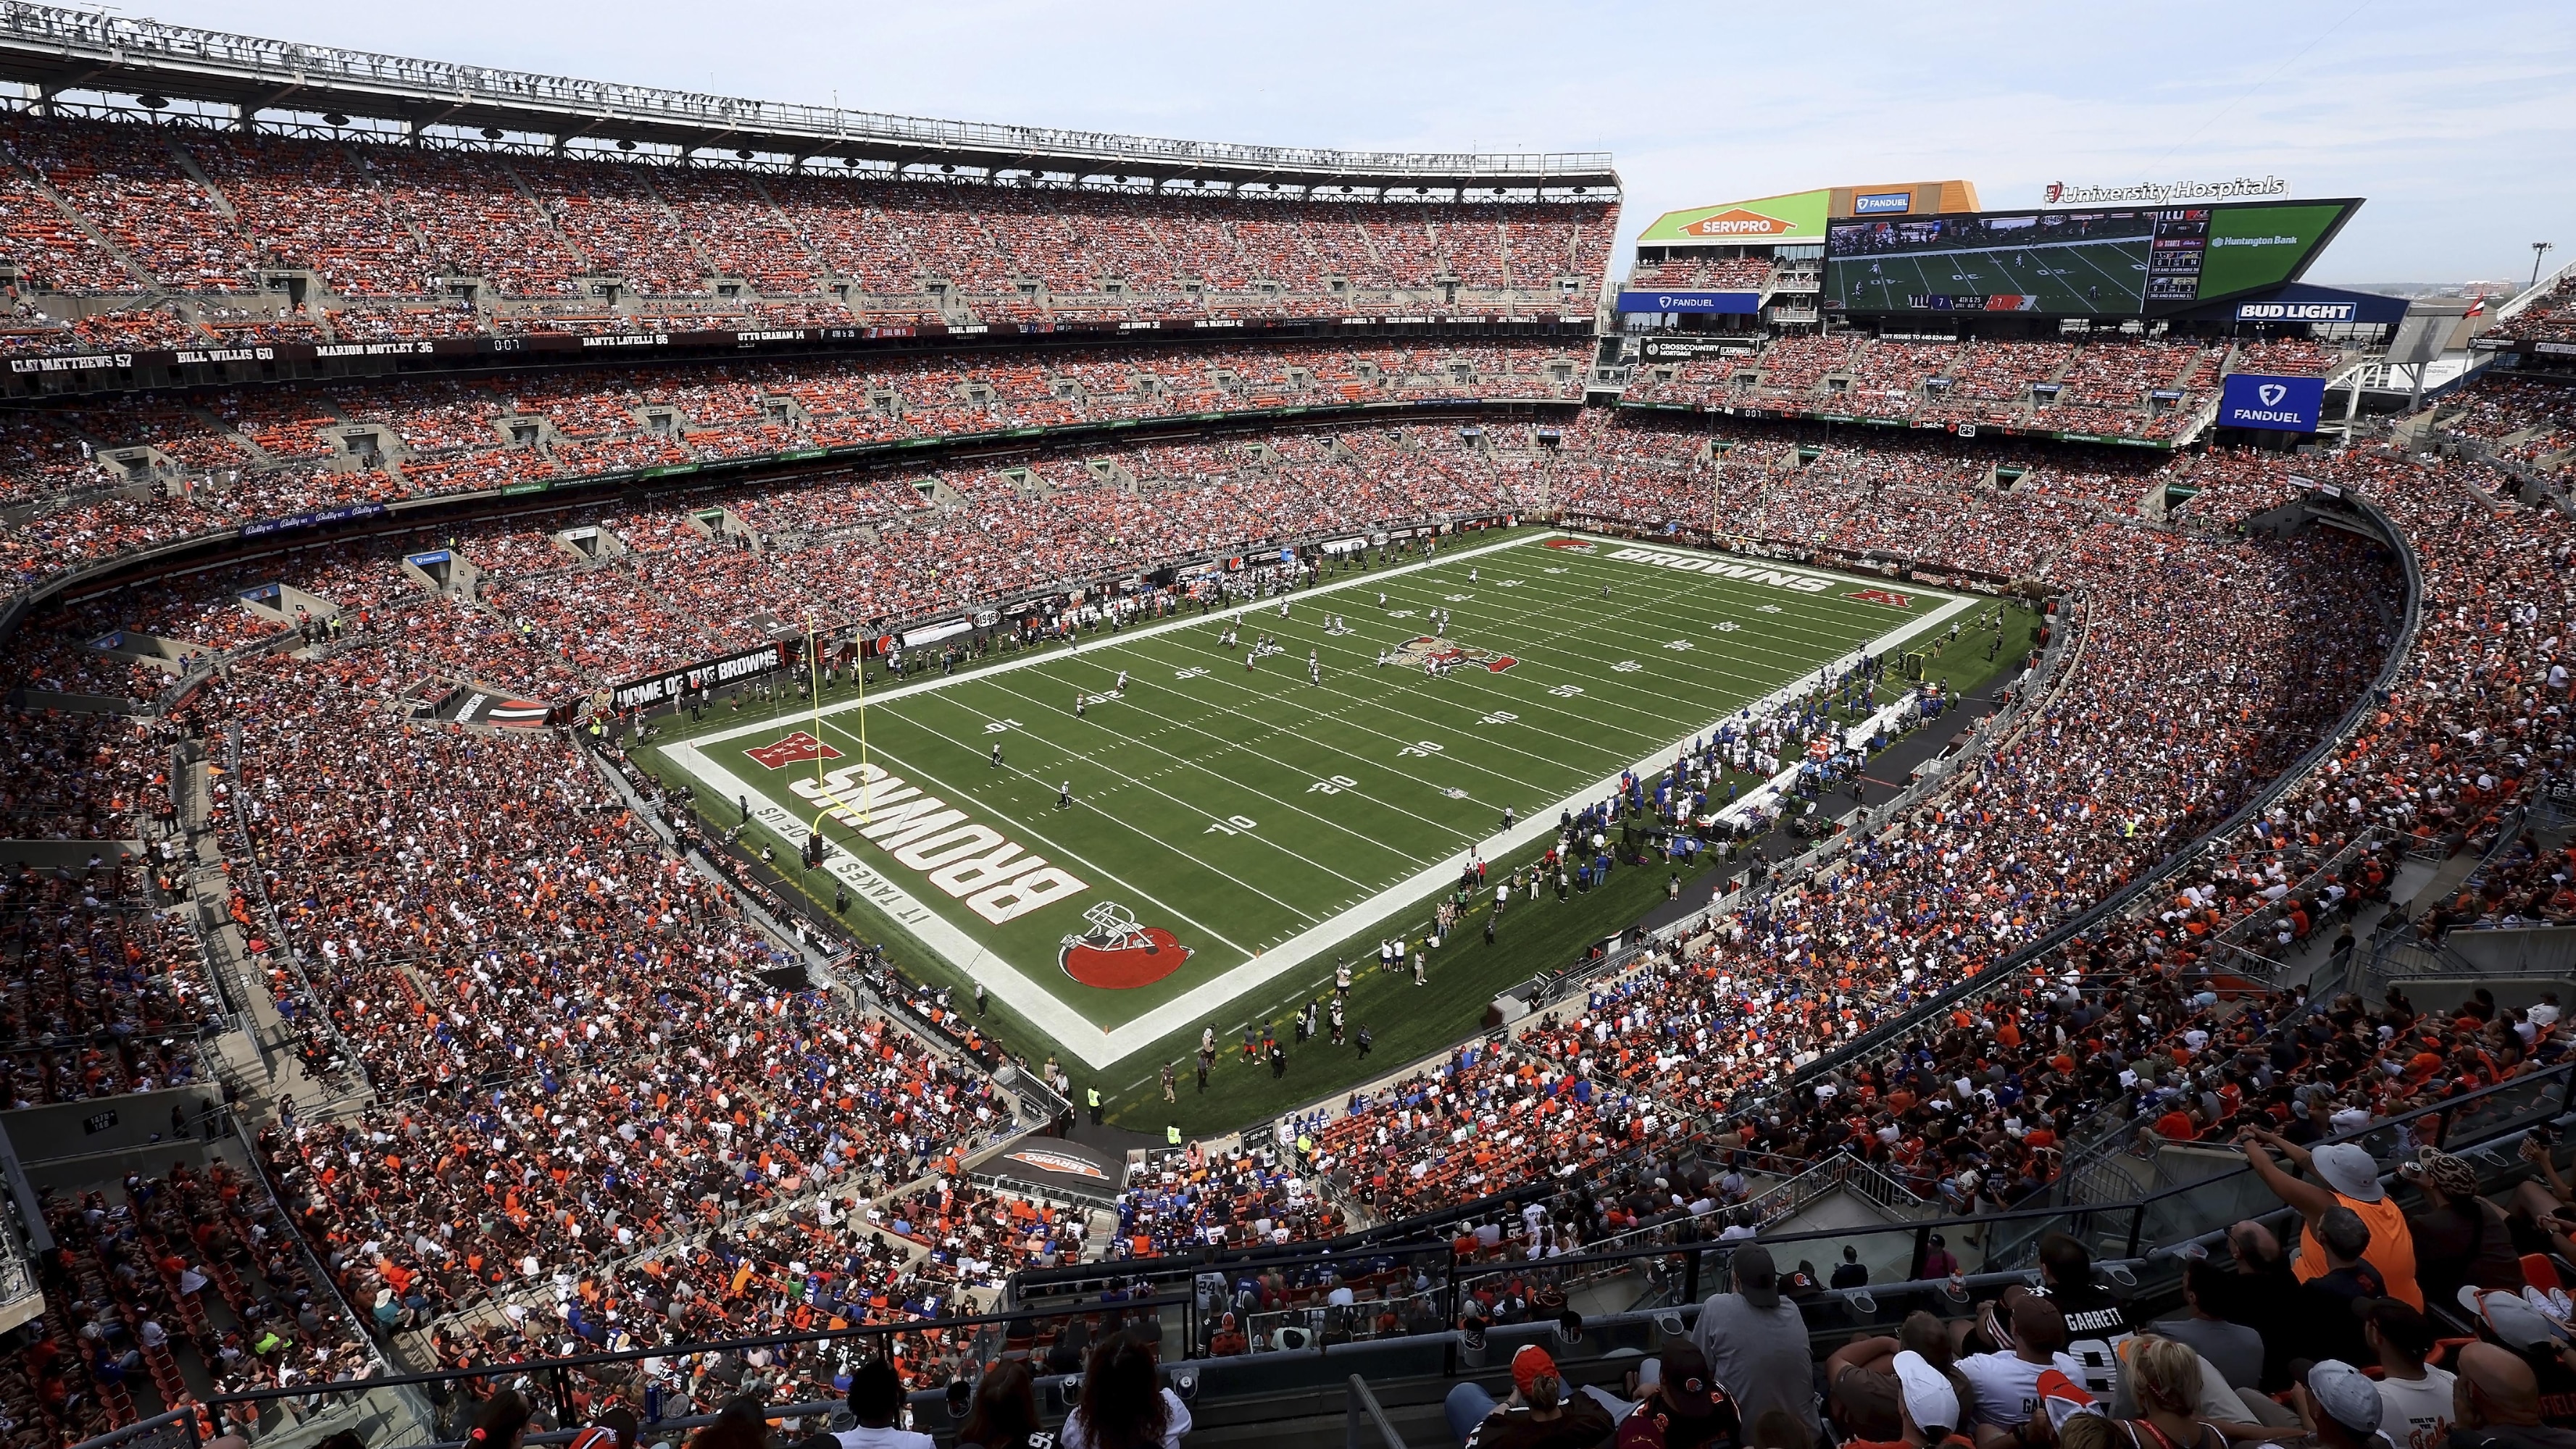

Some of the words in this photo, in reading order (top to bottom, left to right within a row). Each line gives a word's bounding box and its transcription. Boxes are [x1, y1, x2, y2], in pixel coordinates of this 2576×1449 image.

[2063, 182, 2172, 203] University
[2176, 175, 2285, 201] Hospitals
[1870, 199, 1908, 207] FANDUEL
[1702, 220, 1770, 233] SERVPRO
[2162, 224, 2167, 234] 7
[2198, 222, 2204, 233] 7
[2224, 237, 2273, 247] Huntington
[2274, 235, 2297, 244] Bank
[1672, 298, 1714, 307] FANDUEL
[1938, 298, 1944, 306] 7
[1998, 298, 2003, 306] 7
[2241, 304, 2285, 317] BUD
[2286, 305, 2351, 319] LIGHT
[583, 337, 614, 346] DANTE
[616, 335, 654, 346] LAVELLI
[656, 334, 668, 344] 86
[738, 331, 759, 341] OTTO
[762, 330, 793, 341] GRAHAM
[796, 330, 804, 339] 14
[316, 344, 364, 356] MARION
[366, 343, 414, 355] MOTLEY
[417, 342, 433, 354] 36
[494, 339, 520, 351] 0:07
[1660, 343, 1720, 352] CROSSCOUNTRY
[176, 351, 207, 363] BILL
[208, 349, 253, 362] WILLIS
[256, 348, 274, 359] 60
[12, 359, 40, 372] CLAY
[40, 355, 113, 371] MATTHEWS
[114, 354, 132, 367] 57
[2234, 409, 2301, 423] FANDUEL
[1961, 426, 1972, 435] 25
[315, 511, 336, 522] Bally
[352, 506, 372, 516] Bally
[280, 517, 299, 528] Bally
[246, 525, 265, 535] Bally
[1604, 548, 1836, 592] BROWNS
[979, 612, 996, 624] 1946
[1711, 622, 1741, 632] 20
[1663, 640, 1694, 651] 30
[1610, 660, 1643, 672] 40
[617, 682, 663, 707] HOME
[718, 649, 778, 680] BROWNS
[1175, 667, 1211, 680] 30
[1547, 685, 1585, 698] 50
[1086, 690, 1125, 706] 20
[1483, 711, 1519, 724] 40
[984, 718, 1023, 733] 10
[1404, 740, 1444, 758] 30
[1312, 774, 1358, 796] 20
[2553, 786, 2570, 798] 85
[757, 808, 787, 823] US
[779, 824, 809, 838] OF
[1212, 815, 1257, 835] 10
[789, 763, 1091, 924] BROWNS
[837, 862, 903, 906] TAKES
[896, 908, 930, 924] IT
[1250, 1132, 1267, 1141] 102-104
[799, 1143, 804, 1151] 2
[1026, 1155, 1086, 1173] SERVPRO
[1277, 1236, 1286, 1245] 24
[984, 1248, 993, 1257] 95
[1199, 1281, 1216, 1294] 24
[924, 1299, 935, 1311] 97
[2065, 1307, 2124, 1332] GARRETT
